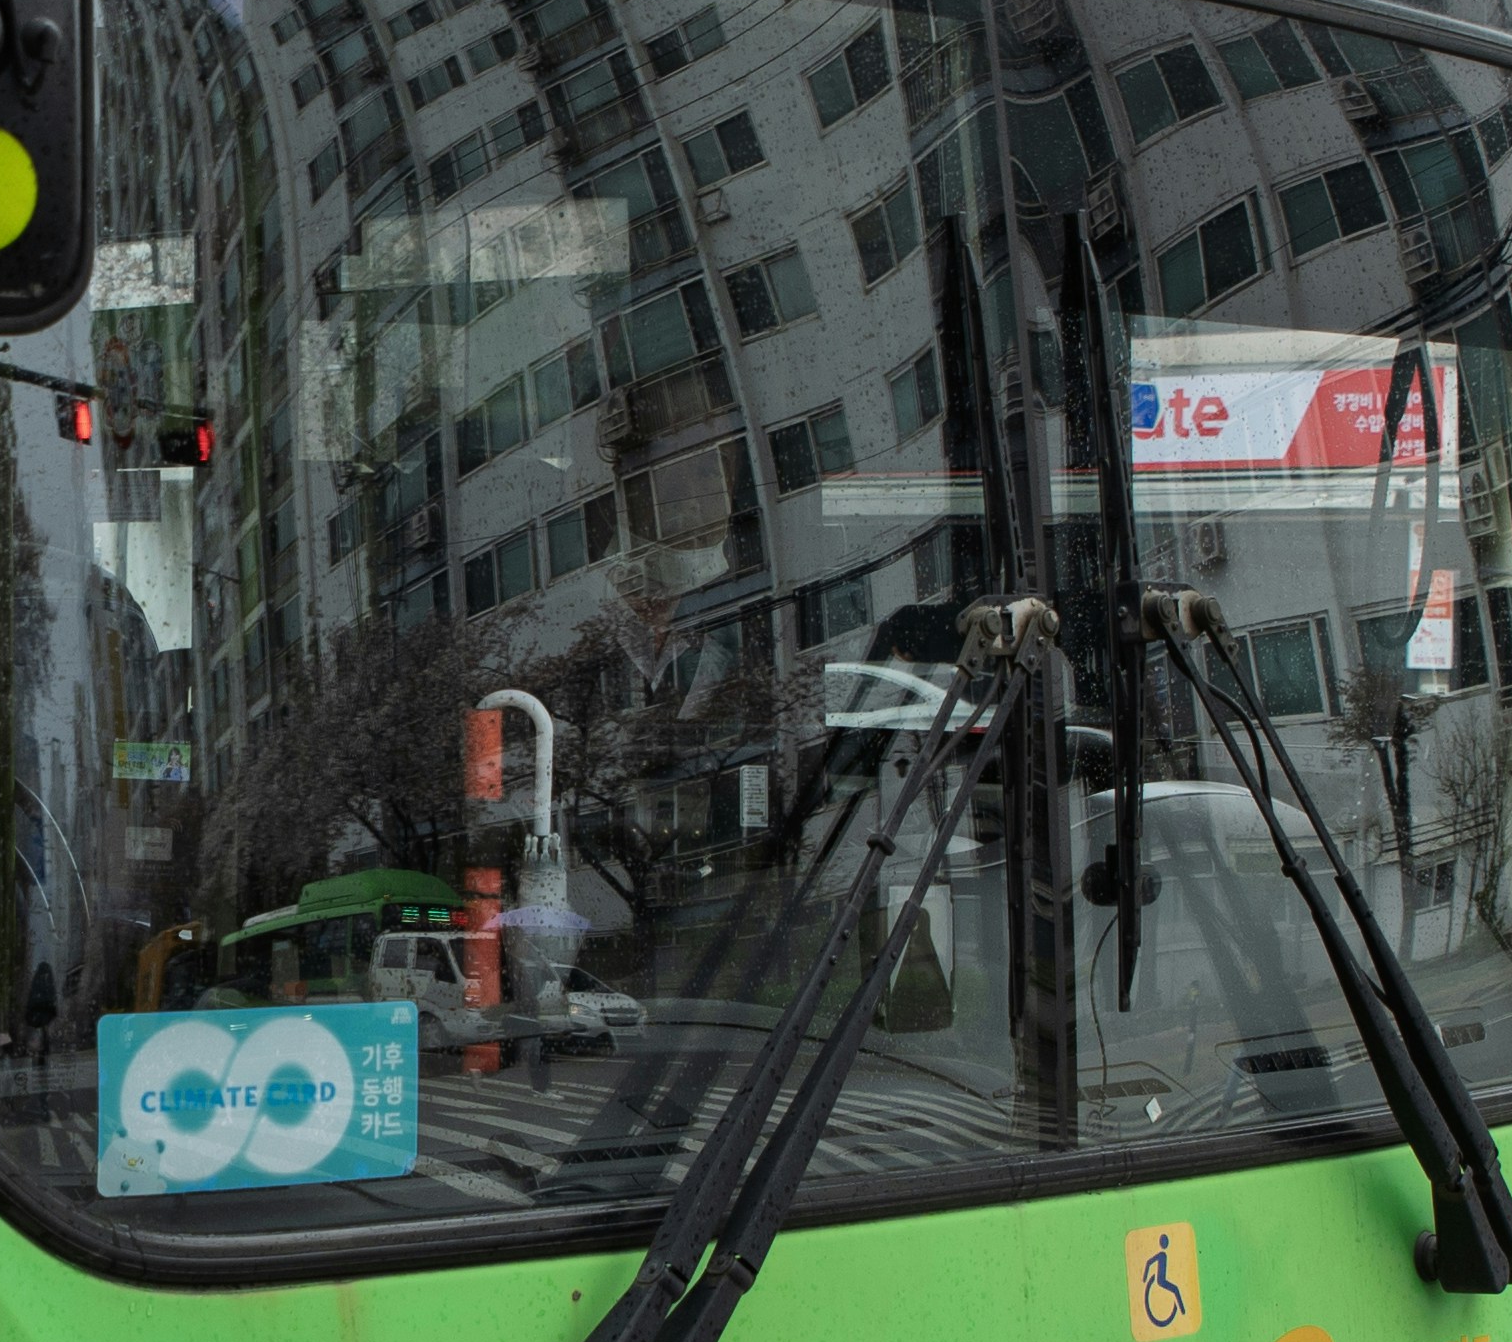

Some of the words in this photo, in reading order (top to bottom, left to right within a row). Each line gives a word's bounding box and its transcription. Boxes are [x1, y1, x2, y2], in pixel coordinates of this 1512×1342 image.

[360, 1041, 405, 1072] 기후
[140, 1085, 258, 1114] CLIMATE
[267, 1080, 337, 1107] CARD
[360, 1075, 404, 1108] 동행
[360, 1110, 404, 1140] 카드
